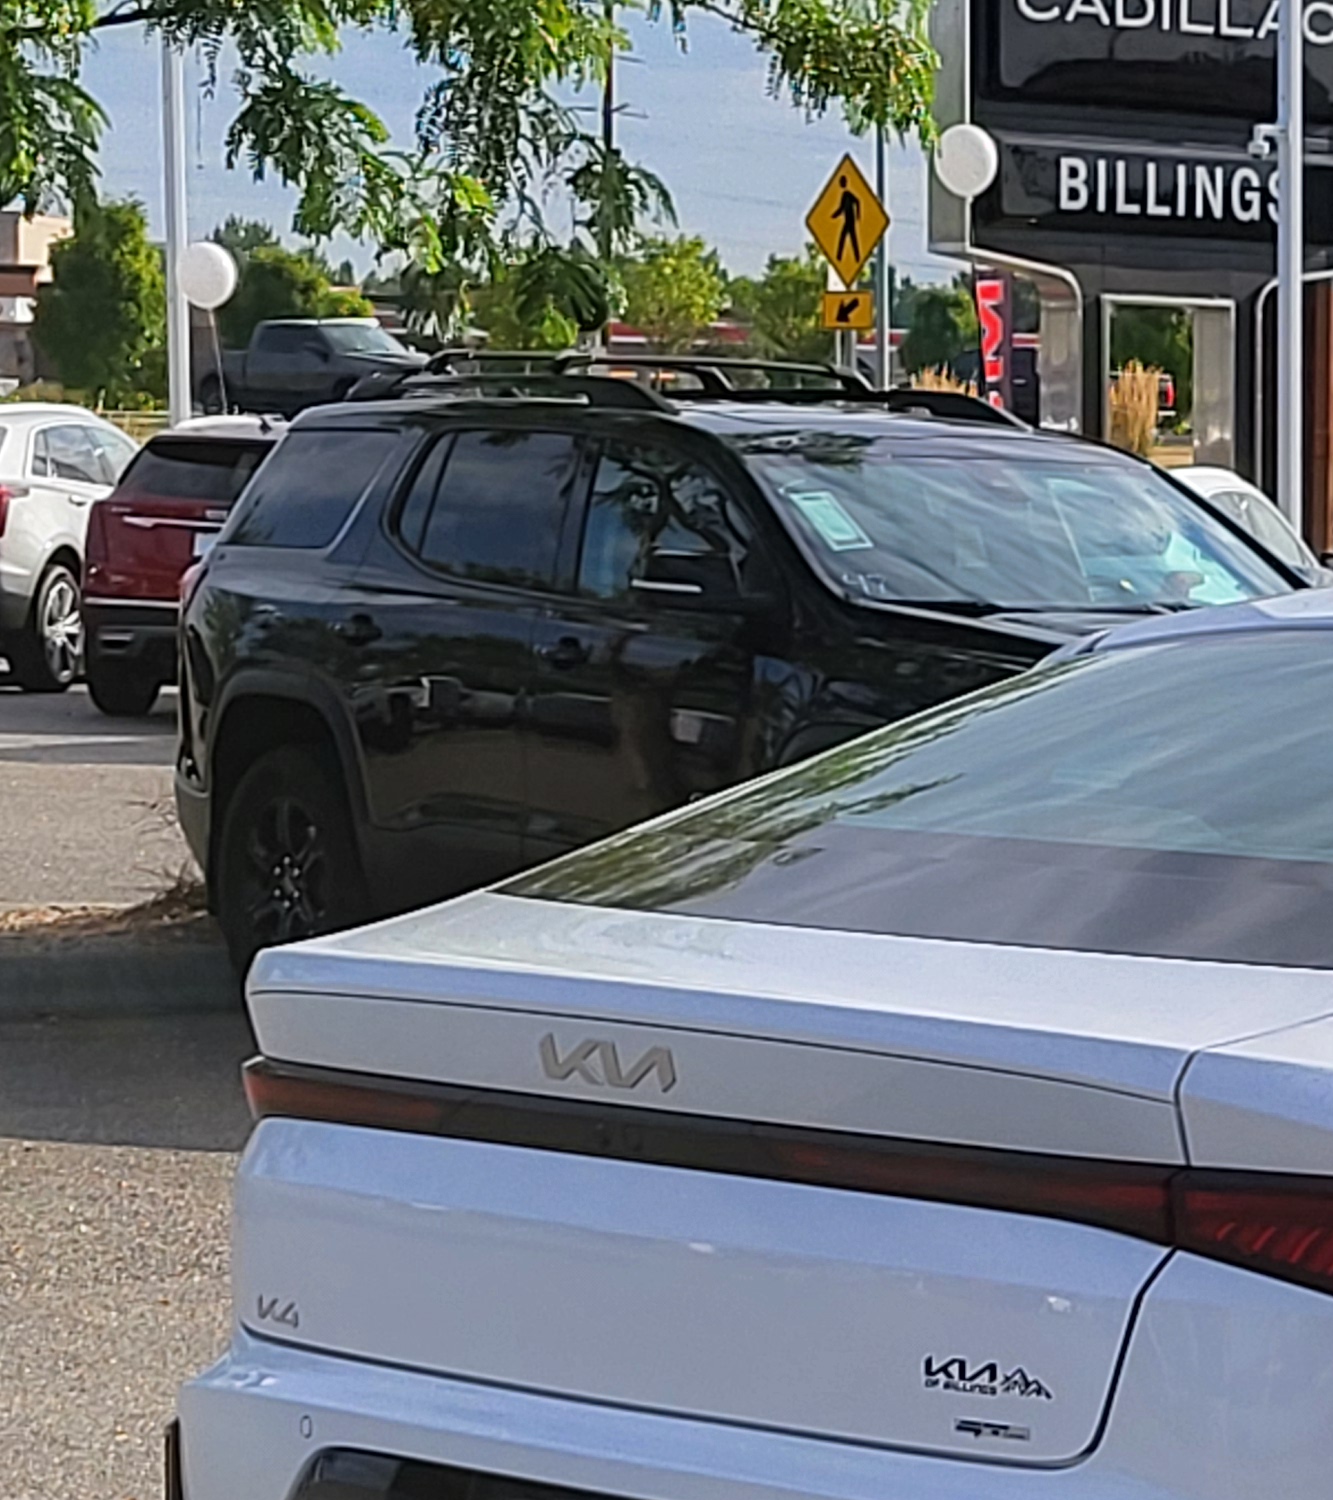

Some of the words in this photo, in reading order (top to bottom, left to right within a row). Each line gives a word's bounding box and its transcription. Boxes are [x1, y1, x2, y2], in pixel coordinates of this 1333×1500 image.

[538, 1032, 677, 1093] KIA
[257, 1294, 299, 1329] K4
[924, 1355, 998, 1384] KIA
